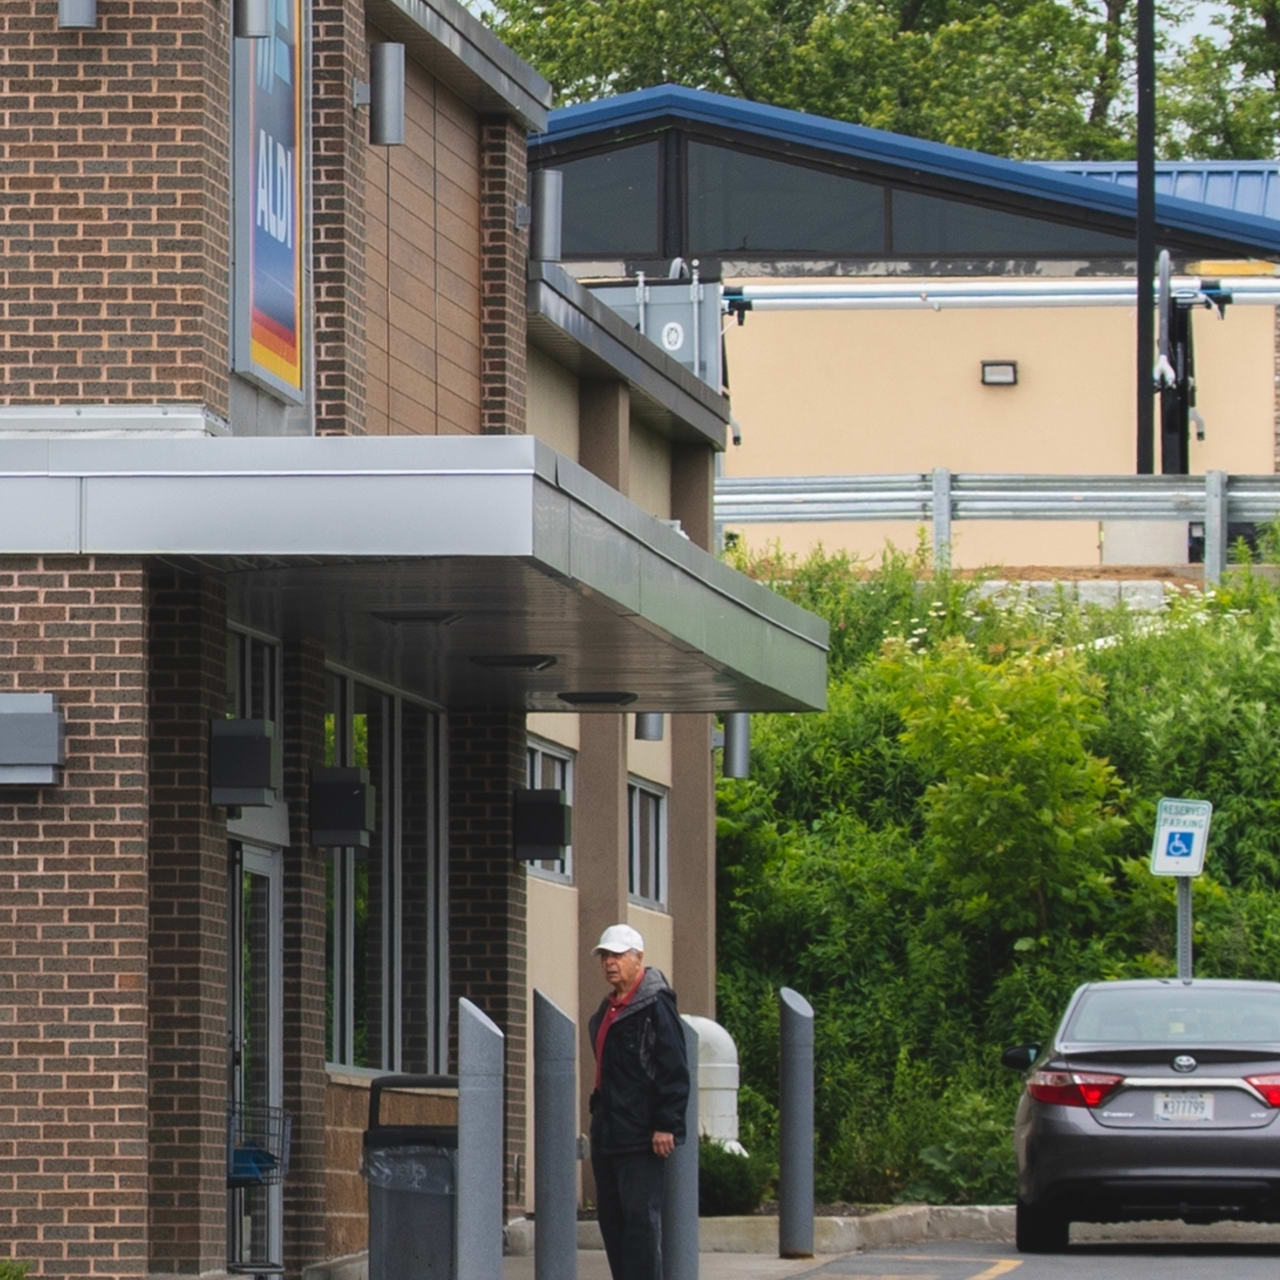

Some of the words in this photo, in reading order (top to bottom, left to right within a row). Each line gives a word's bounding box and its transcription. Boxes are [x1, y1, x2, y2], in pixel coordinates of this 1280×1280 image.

[256, 128, 292, 249] ALDI
[1163, 804, 1208, 816] RESERVED
[1162, 818, 1204, 829] PARKING
